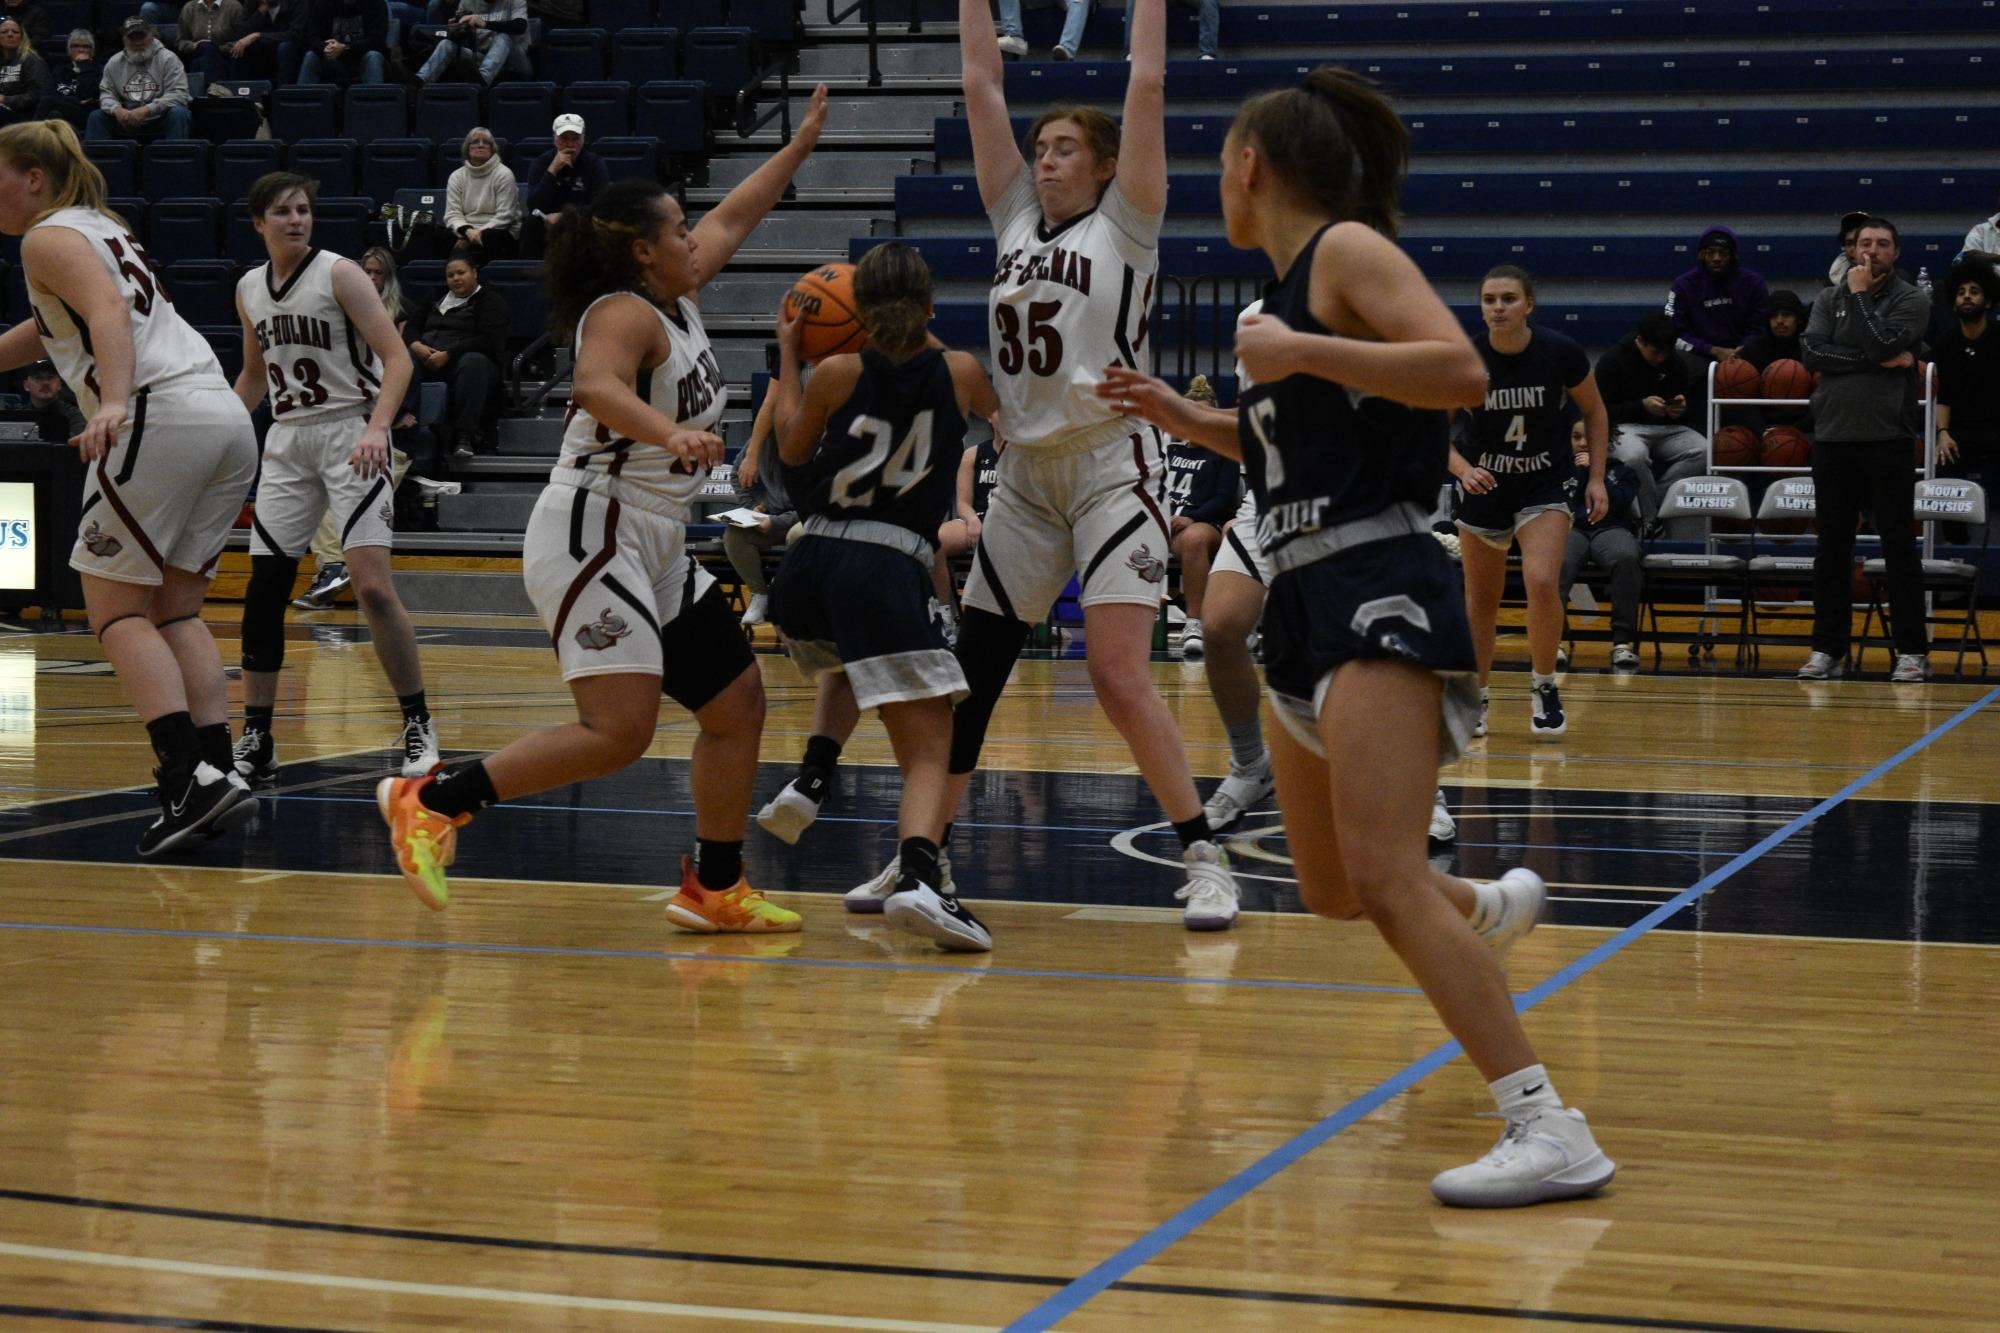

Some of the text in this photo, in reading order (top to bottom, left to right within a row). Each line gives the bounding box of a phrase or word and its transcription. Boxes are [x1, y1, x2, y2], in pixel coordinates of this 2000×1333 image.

[995, 300, 1063, 376] 35
[268, 357, 328, 415] 23
[1484, 386, 1546, 411] MOUNT
[1504, 415, 1528, 451] 4
[828, 409, 935, 509] 24
[1478, 451, 1552, 474] ALOYSIUS
[979, 469, 998, 484] MO
[1685, 483, 1730, 494] MOUNT
[1923, 486, 1970, 497] MOUNT
[1676, 496, 1735, 508] ALOYSIUS
[1914, 499, 1974, 512] ALOYSIUS
